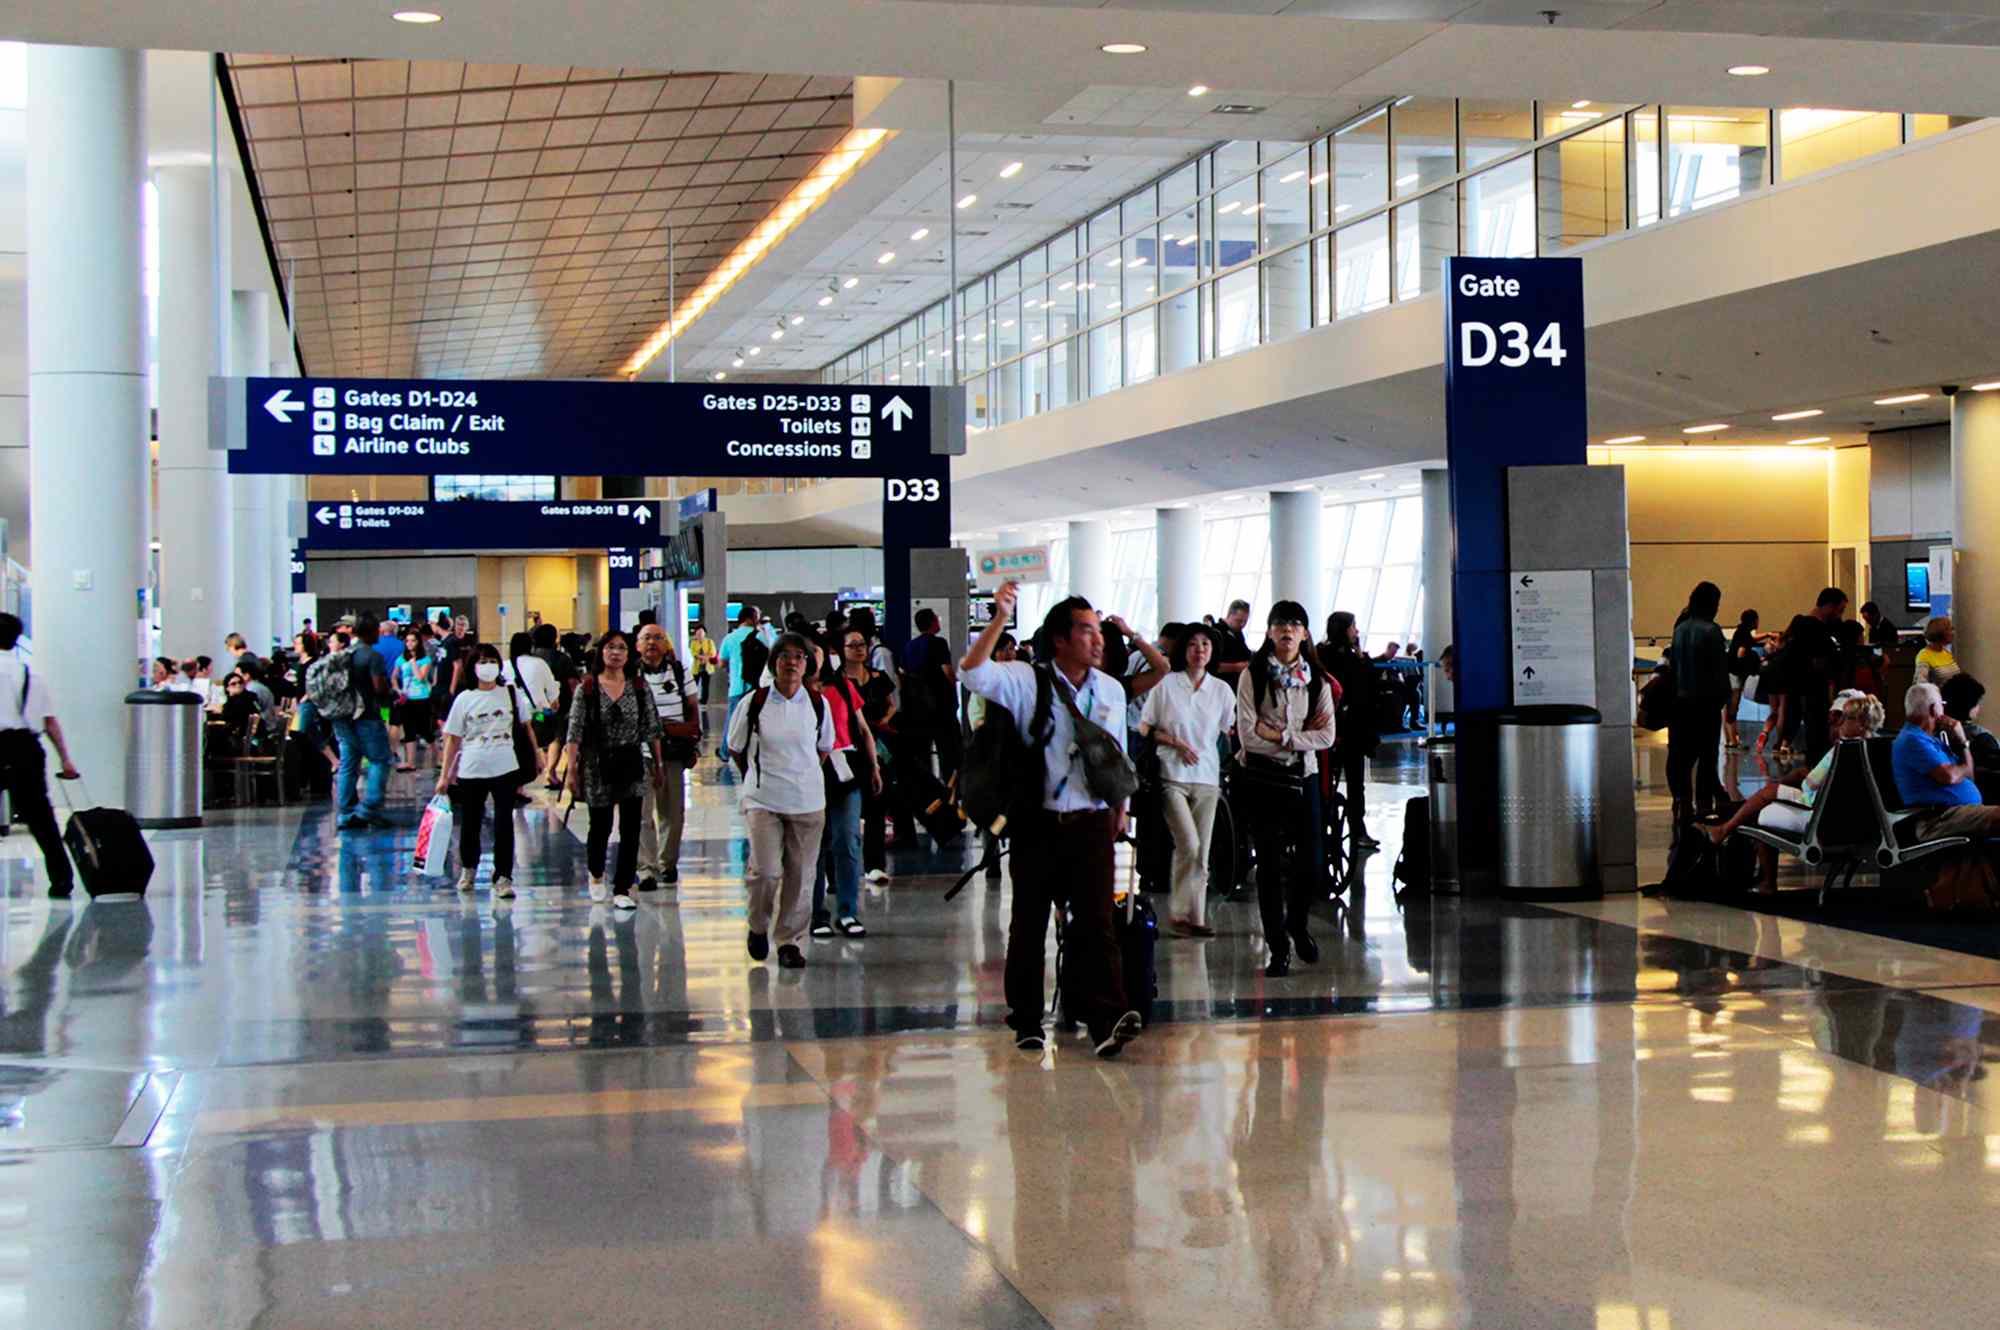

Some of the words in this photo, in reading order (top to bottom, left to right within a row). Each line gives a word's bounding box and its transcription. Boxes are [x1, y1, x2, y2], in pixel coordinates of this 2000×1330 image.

[1459, 274, 1520, 296] Gate
[1460, 321, 1567, 367] D34
[344, 390, 402, 407] Gates
[408, 391, 478, 407] D1-D24
[703, 394, 757, 411] Gates
[763, 395, 841, 411] D25-D33
[345, 414, 383, 434] Bag
[389, 414, 445, 431] Claim
[450, 414, 464, 432] /
[469, 415, 505, 431] Exit
[779, 417, 842, 434] Toilets
[344, 437, 409, 454] Airline
[415, 437, 470, 454] Clubs
[726, 440, 842, 457] Concessions
[887, 479, 940, 501] D33
[355, 506, 386, 516] Gates
[540, 505, 570, 515] Gates
[355, 518, 391, 528] Toilets
[290, 561, 305, 574] 30
[609, 555, 634, 568] D31
